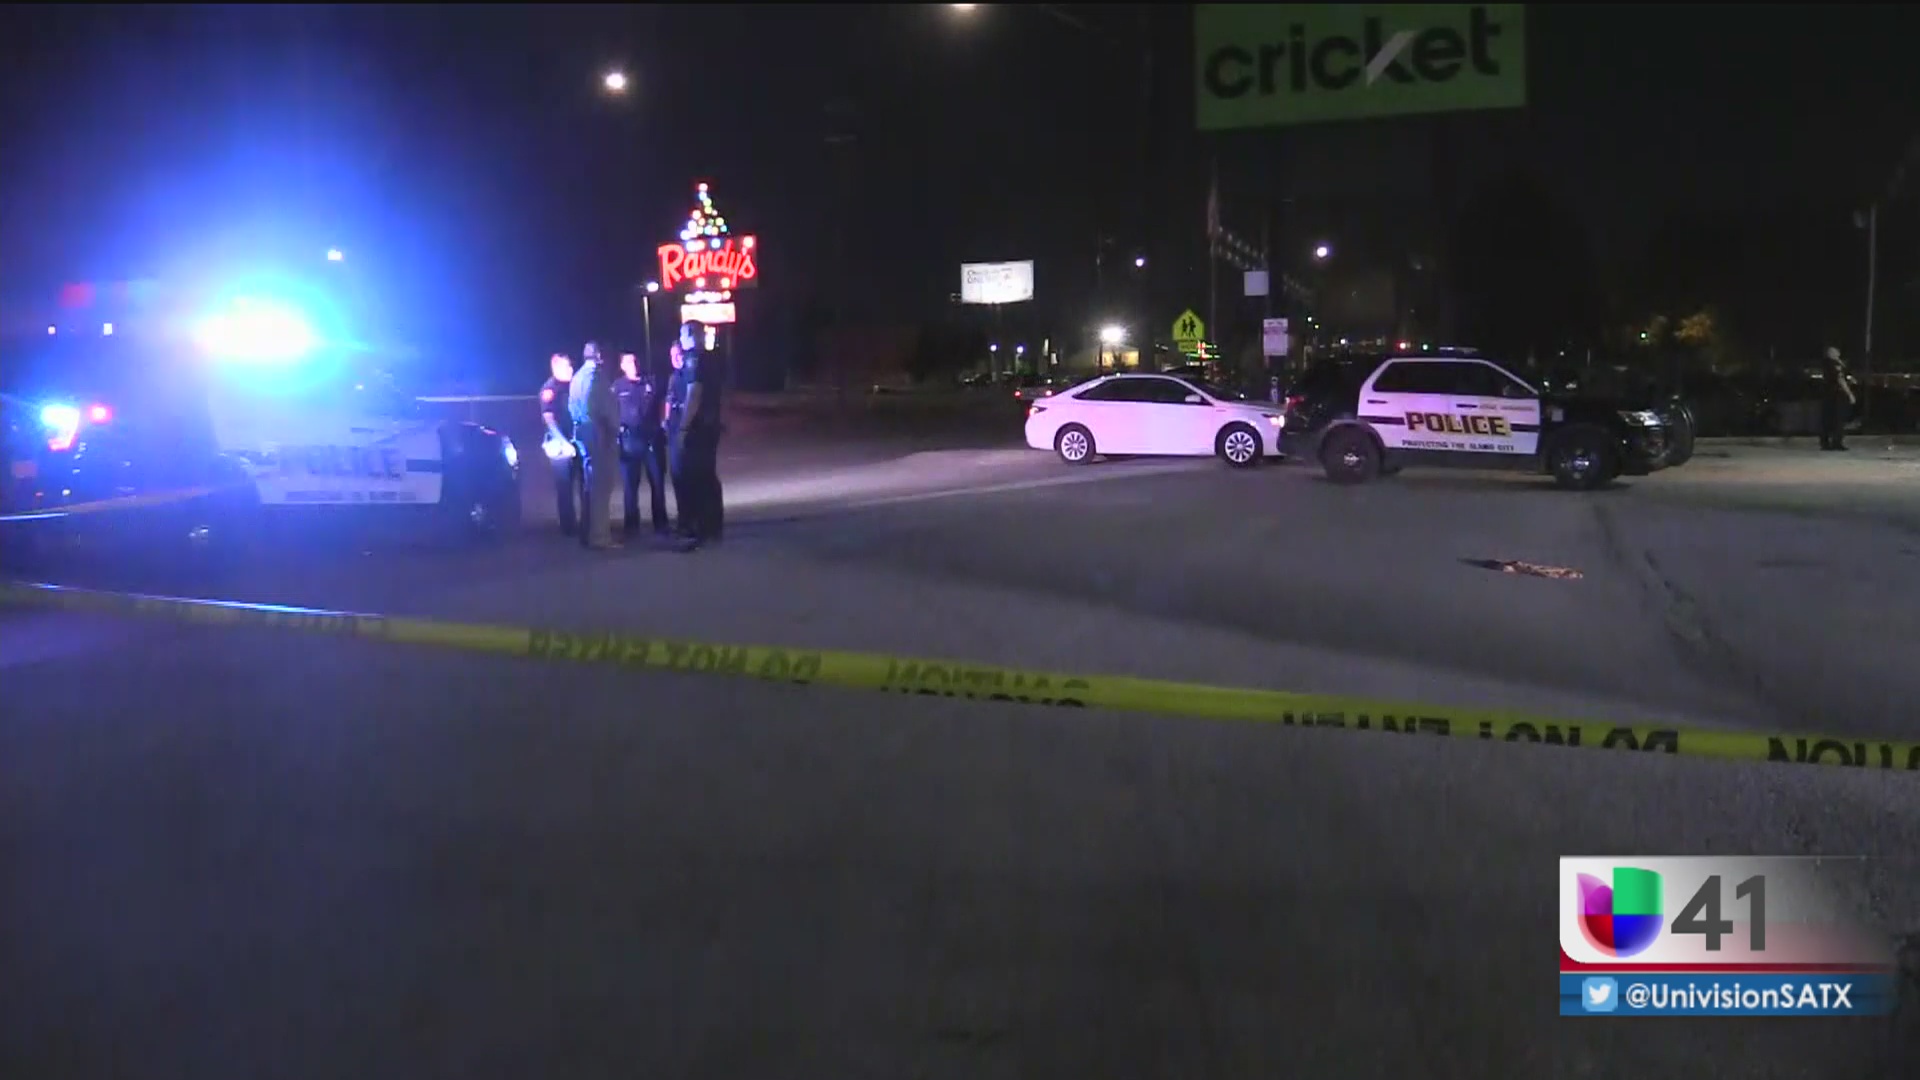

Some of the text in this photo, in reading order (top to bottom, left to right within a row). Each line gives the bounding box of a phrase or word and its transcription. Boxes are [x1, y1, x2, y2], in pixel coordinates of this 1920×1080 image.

[1204, 5, 1501, 99] cricket
[657, 239, 756, 290] Randy's
[1404, 411, 1510, 437] POLICE
